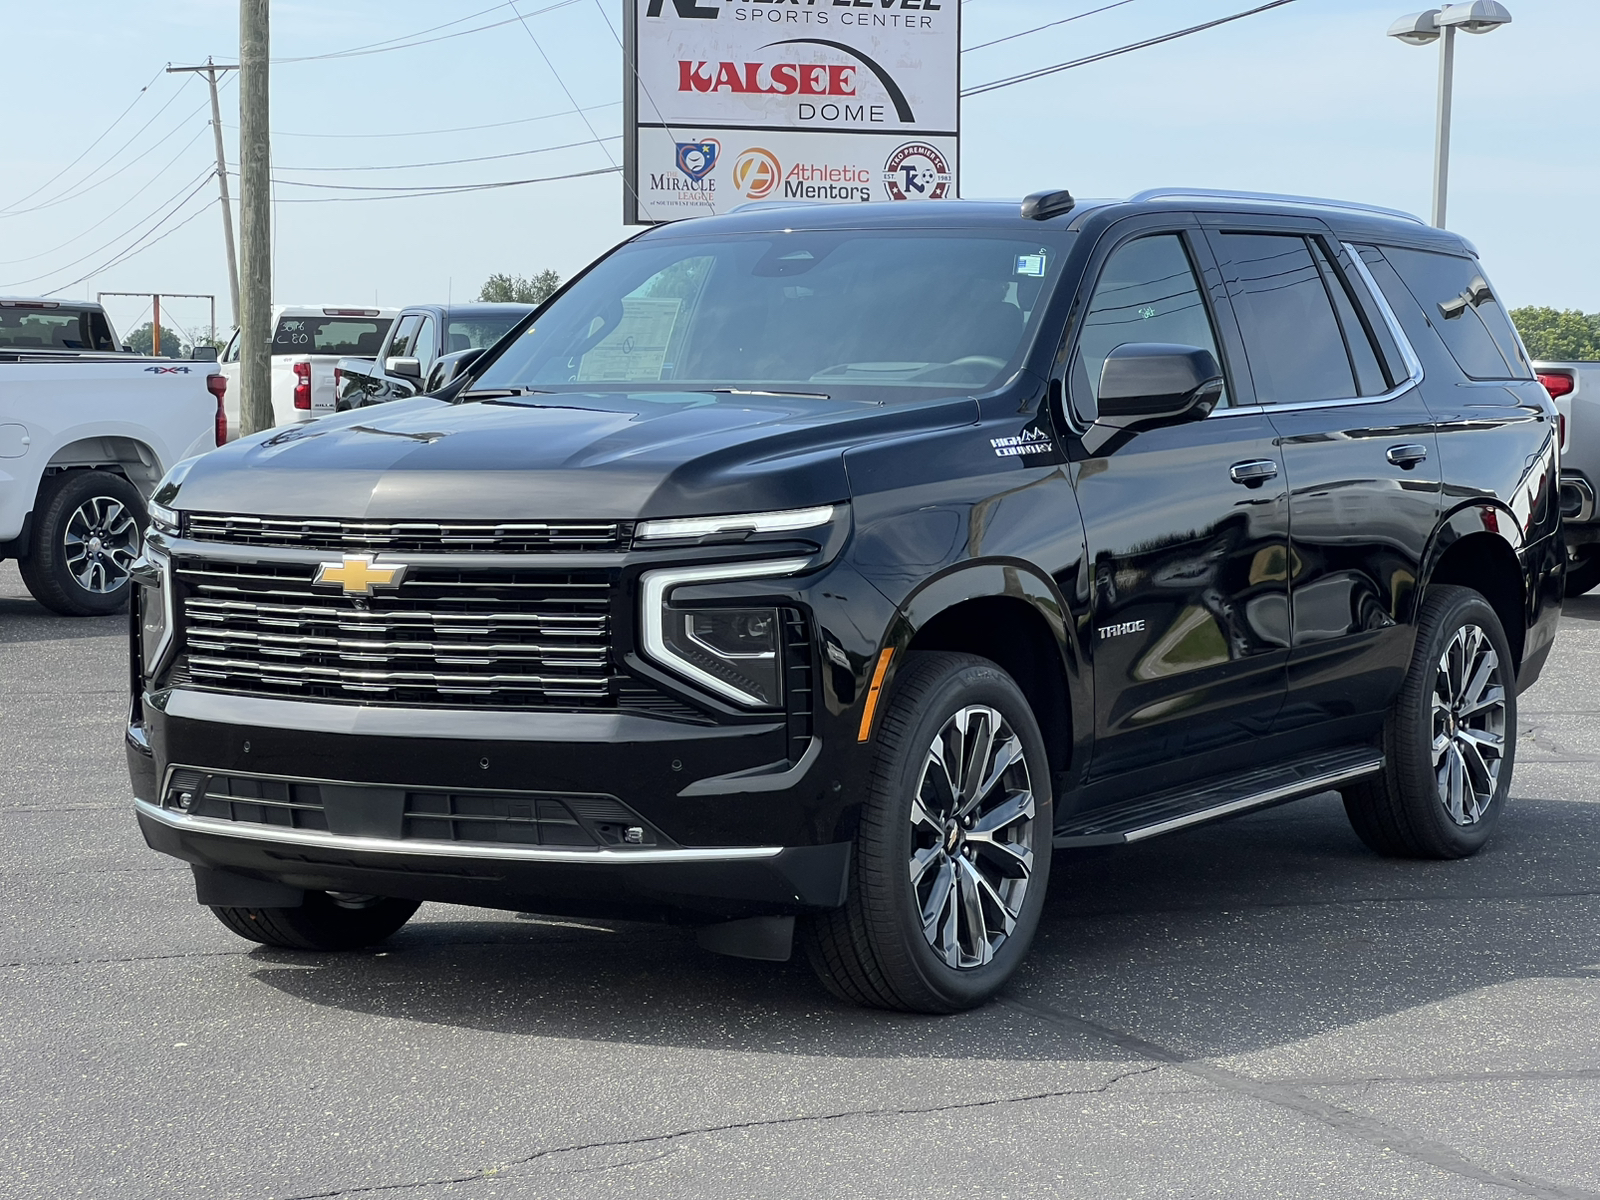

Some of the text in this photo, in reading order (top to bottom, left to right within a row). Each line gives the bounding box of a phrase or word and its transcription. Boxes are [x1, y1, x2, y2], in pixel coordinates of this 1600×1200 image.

[735, 8, 829, 24] SPORTS
[840, 12, 932, 28] CENTER
[678, 60, 856, 96] KALSEE
[798, 103, 885, 122] DOME
[891, 146, 943, 169] TKO PREMIER SC
[785, 163, 870, 183] Athletic
[678, 192, 714, 201] LEAGUE
[784, 180, 870, 200] Mentors
[989, 437, 1022, 448] HIGH
[995, 443, 1052, 457] COUNTRY
[1098, 619, 1145, 639] TAHOE
